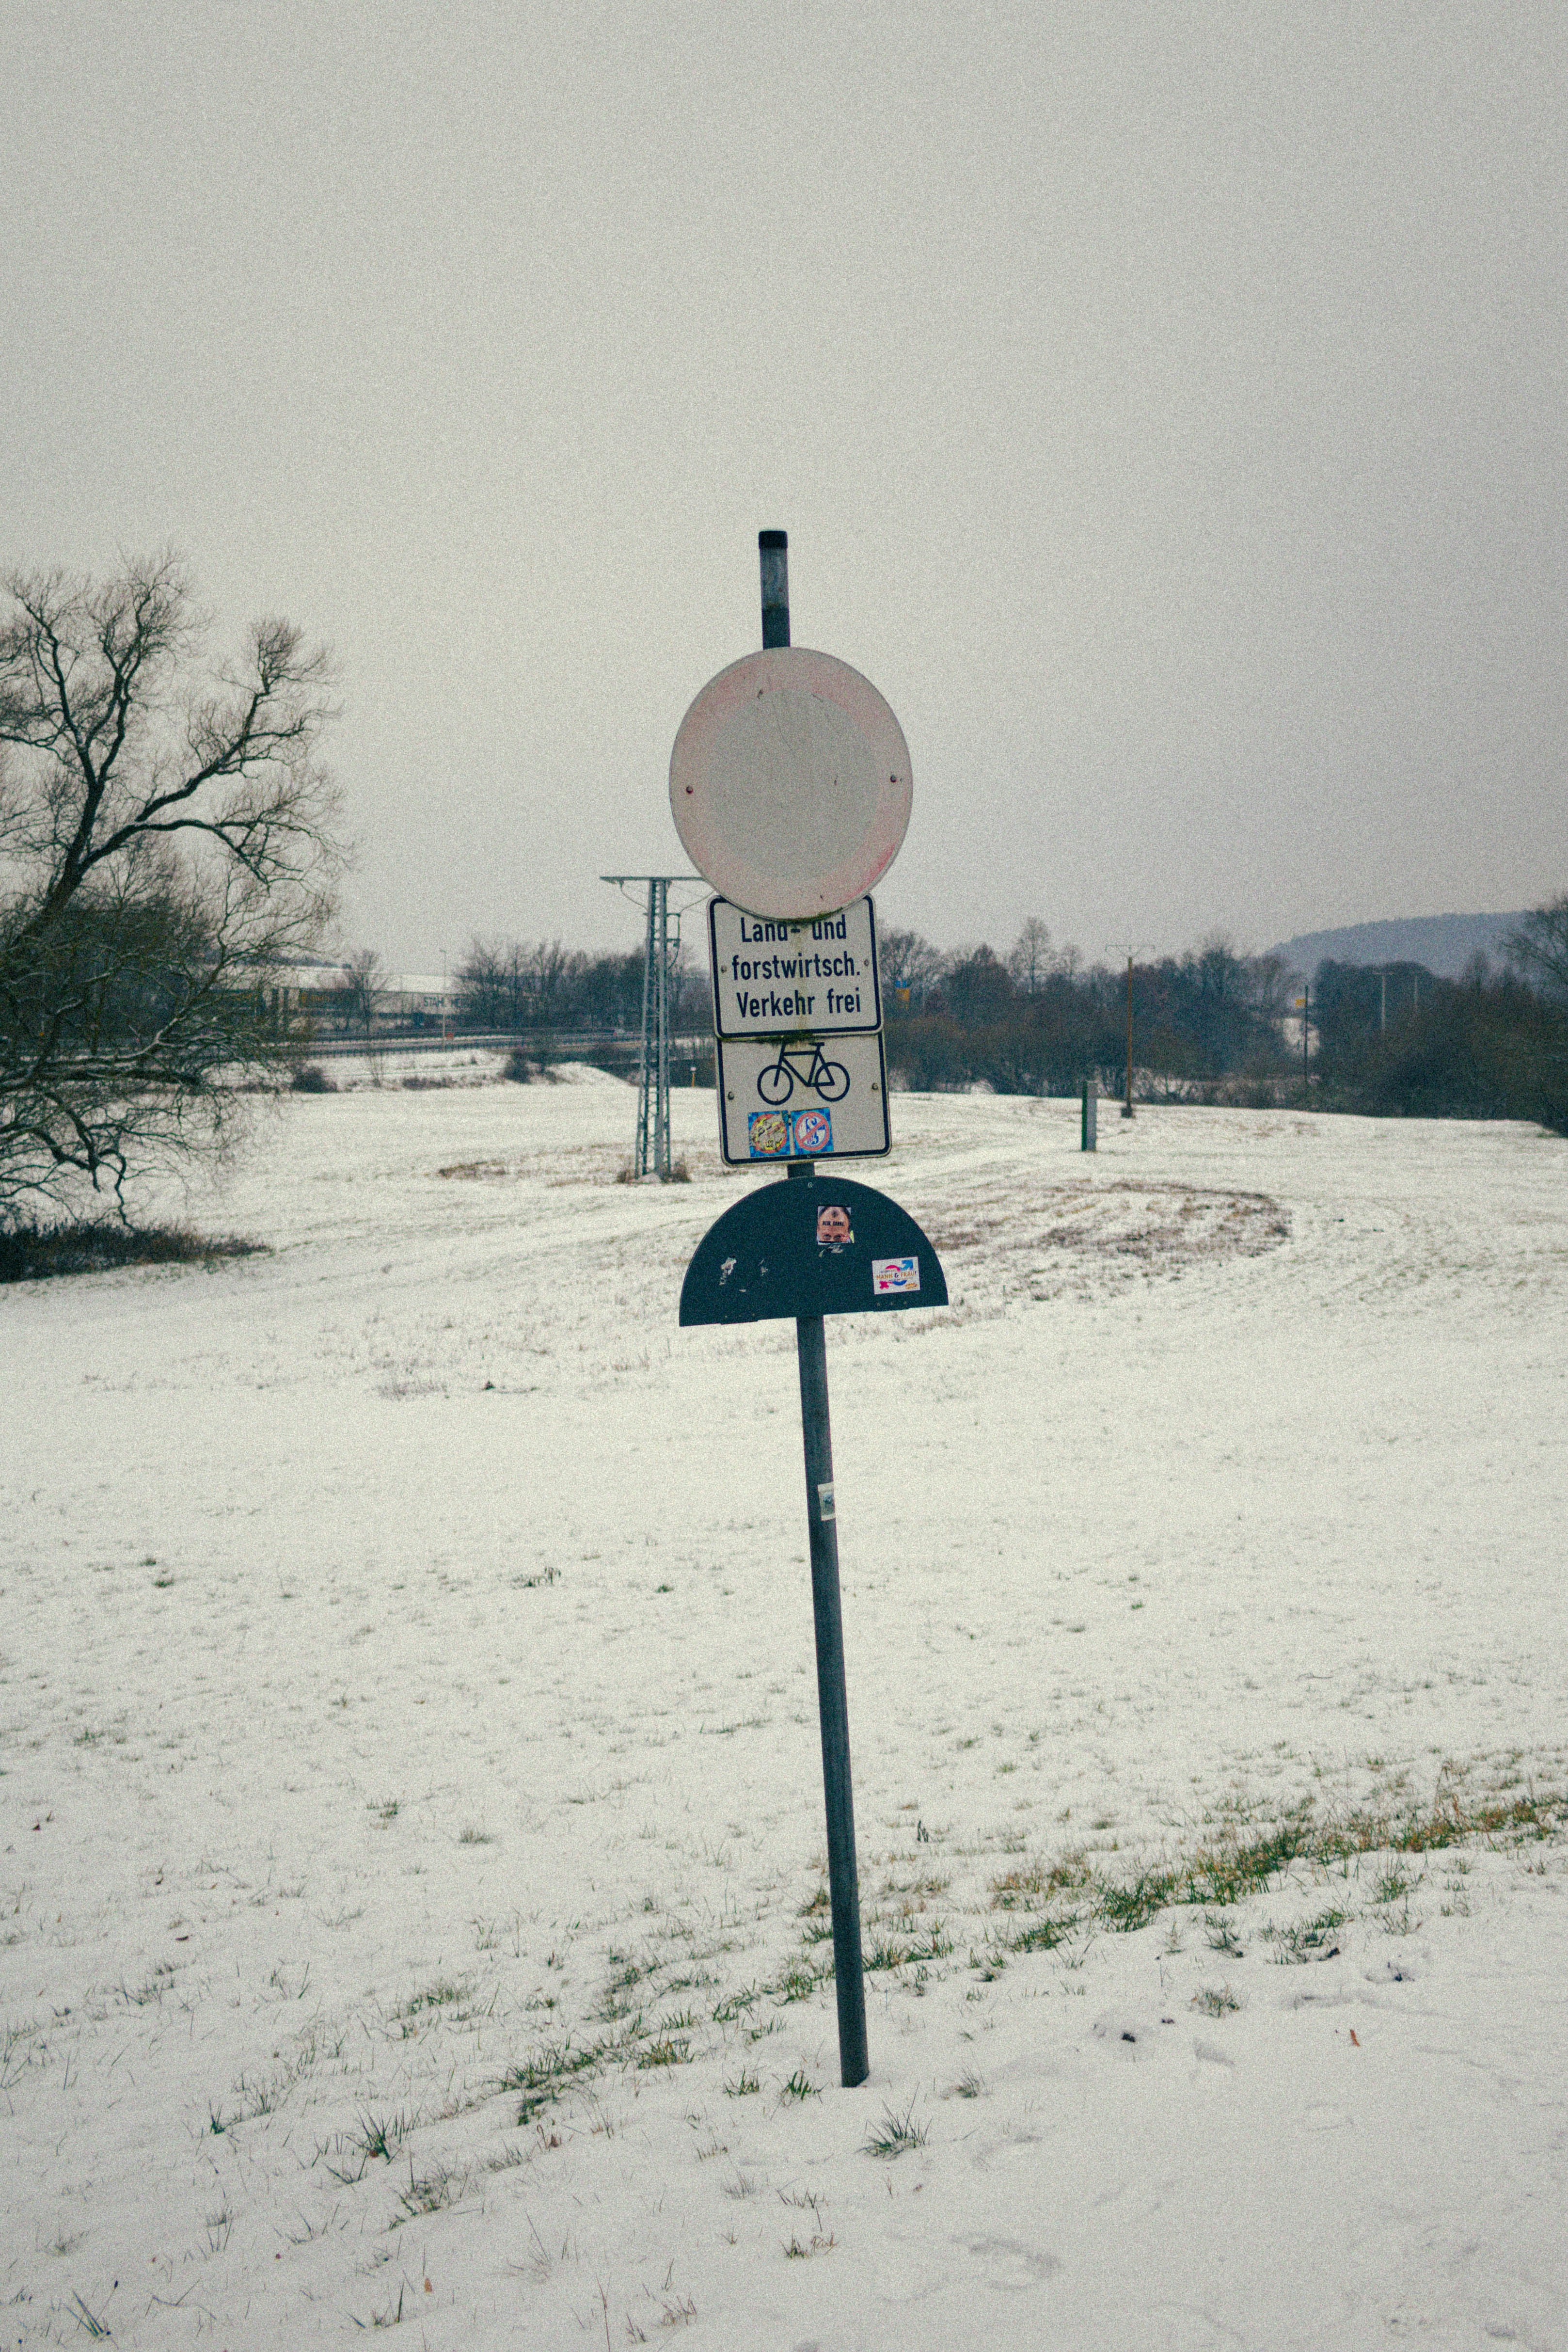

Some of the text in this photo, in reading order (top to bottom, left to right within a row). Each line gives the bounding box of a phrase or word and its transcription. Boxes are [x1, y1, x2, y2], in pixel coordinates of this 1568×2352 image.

[741, 914, 847, 942] Land- und
[732, 951, 860, 980] forstwirtsch.
[737, 987, 861, 1017] Verkehr frei
